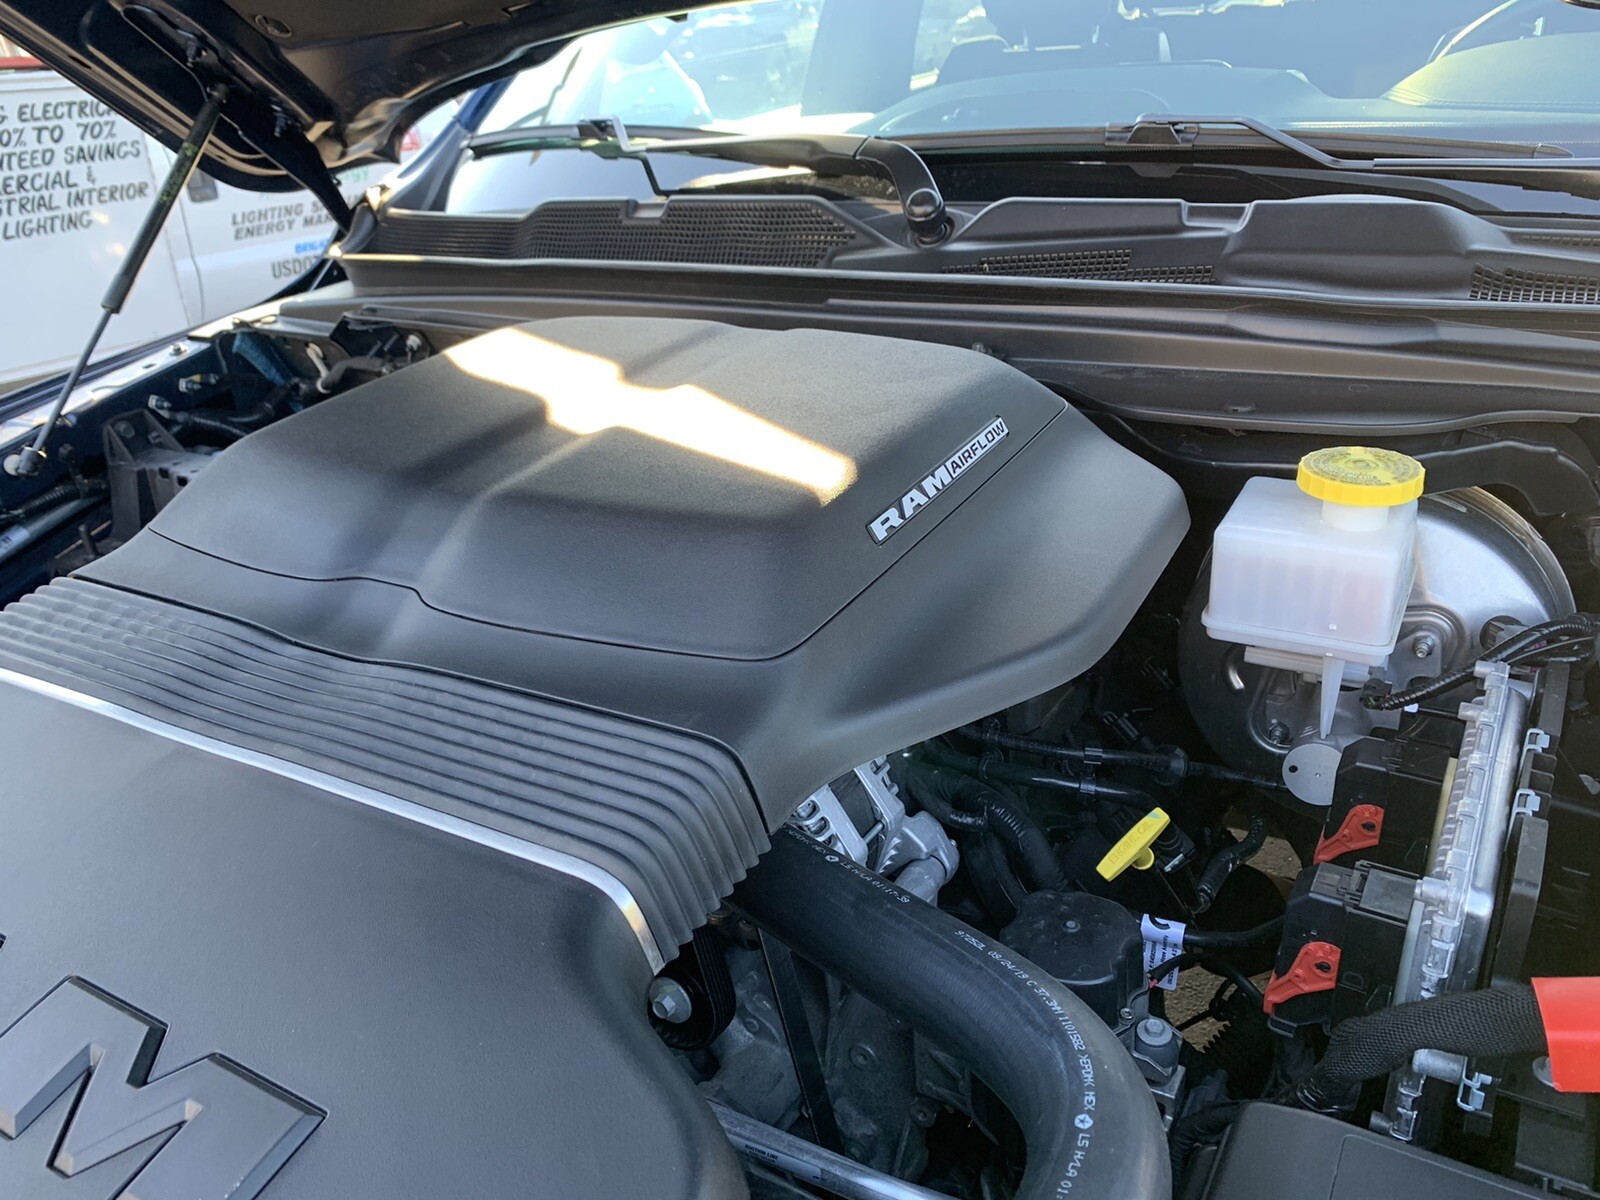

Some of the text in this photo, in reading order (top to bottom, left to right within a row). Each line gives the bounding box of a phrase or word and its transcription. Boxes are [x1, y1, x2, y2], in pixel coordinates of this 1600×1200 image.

[32, 125, 63, 144] TO
[76, 120, 117, 140] 70%
[64, 140, 140, 164] SAVINGS
[0, 170, 78, 195] ERCIAL
[0, 182, 149, 215] TRIAL INTERIOR
[2, 211, 93, 240] LIGHTING
[231, 203, 304, 226] LIGHTING
[233, 219, 296, 241] ENERGY
[870, 421, 1005, 541] RAM AIRFLOW
[1084, 1091, 1096, 1111] MEX
[1078, 1133, 1090, 1148] LS
